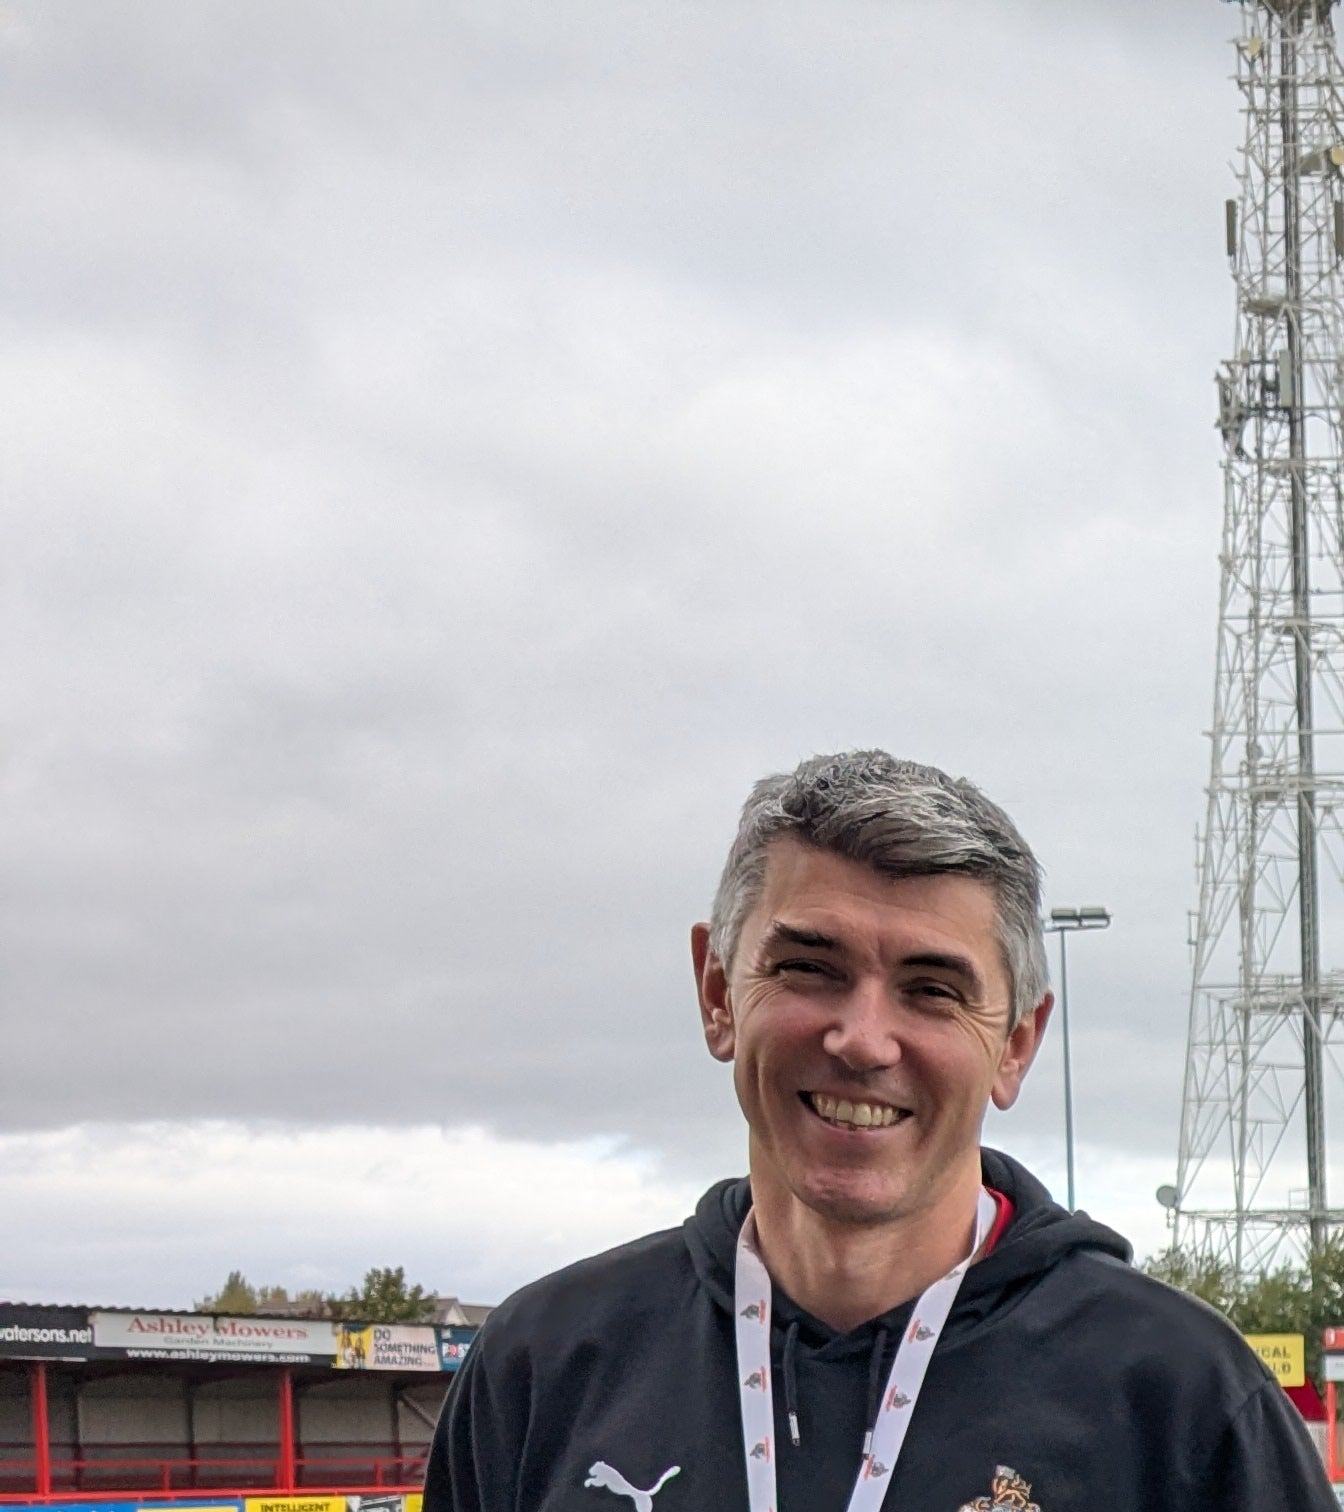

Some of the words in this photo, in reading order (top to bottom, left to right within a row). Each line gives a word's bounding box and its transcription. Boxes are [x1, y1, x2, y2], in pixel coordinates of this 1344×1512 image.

[127, 1316, 208, 1338] Ashley
[373, 1328, 391, 1341] DO
[126, 1348, 311, 1364] www.ashleymowers.com
[373, 1343, 436, 1355] SOMETHING
